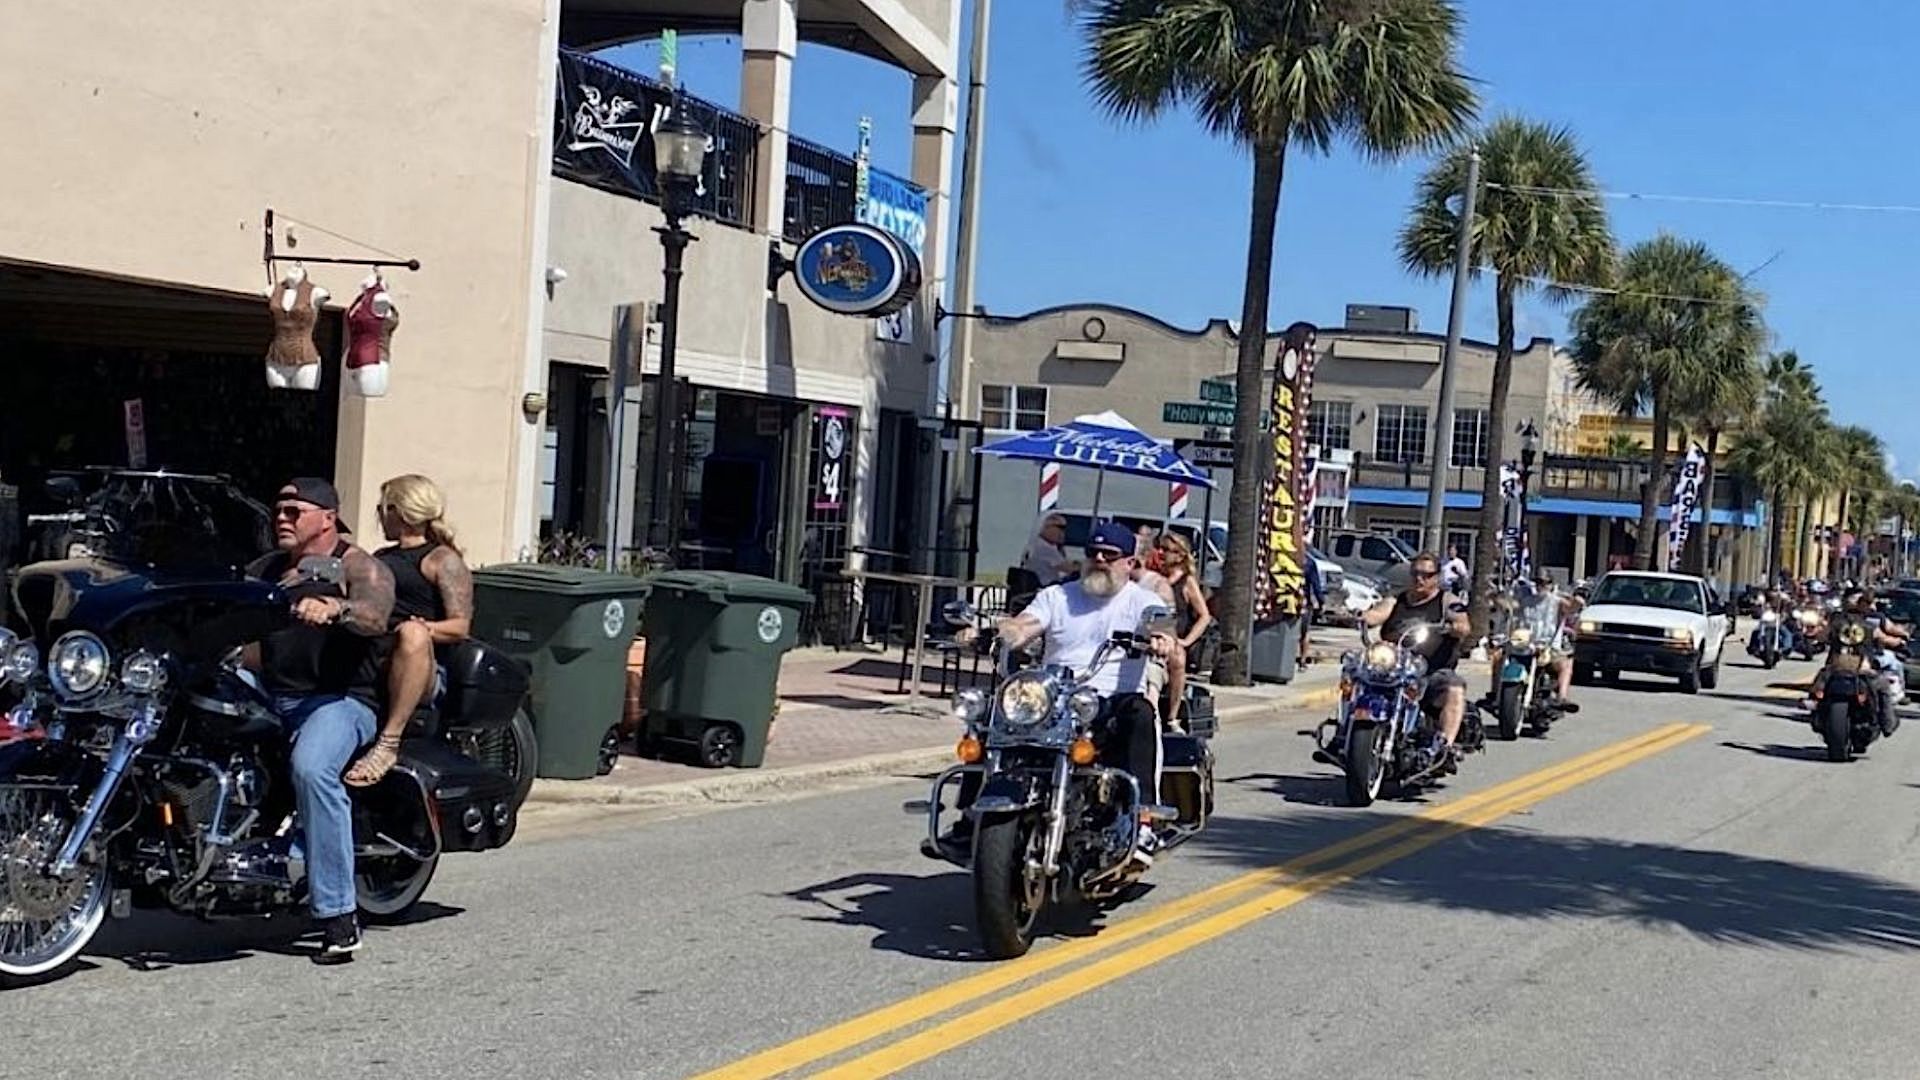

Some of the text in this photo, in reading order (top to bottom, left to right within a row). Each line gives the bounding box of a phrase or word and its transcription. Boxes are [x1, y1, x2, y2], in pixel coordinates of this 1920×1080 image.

[1170, 405, 1235, 425] Hollywoo
[1053, 442, 1194, 478] ULTRA
[822, 462, 841, 503] $4
[1270, 384, 1305, 615] RESTAURANT
